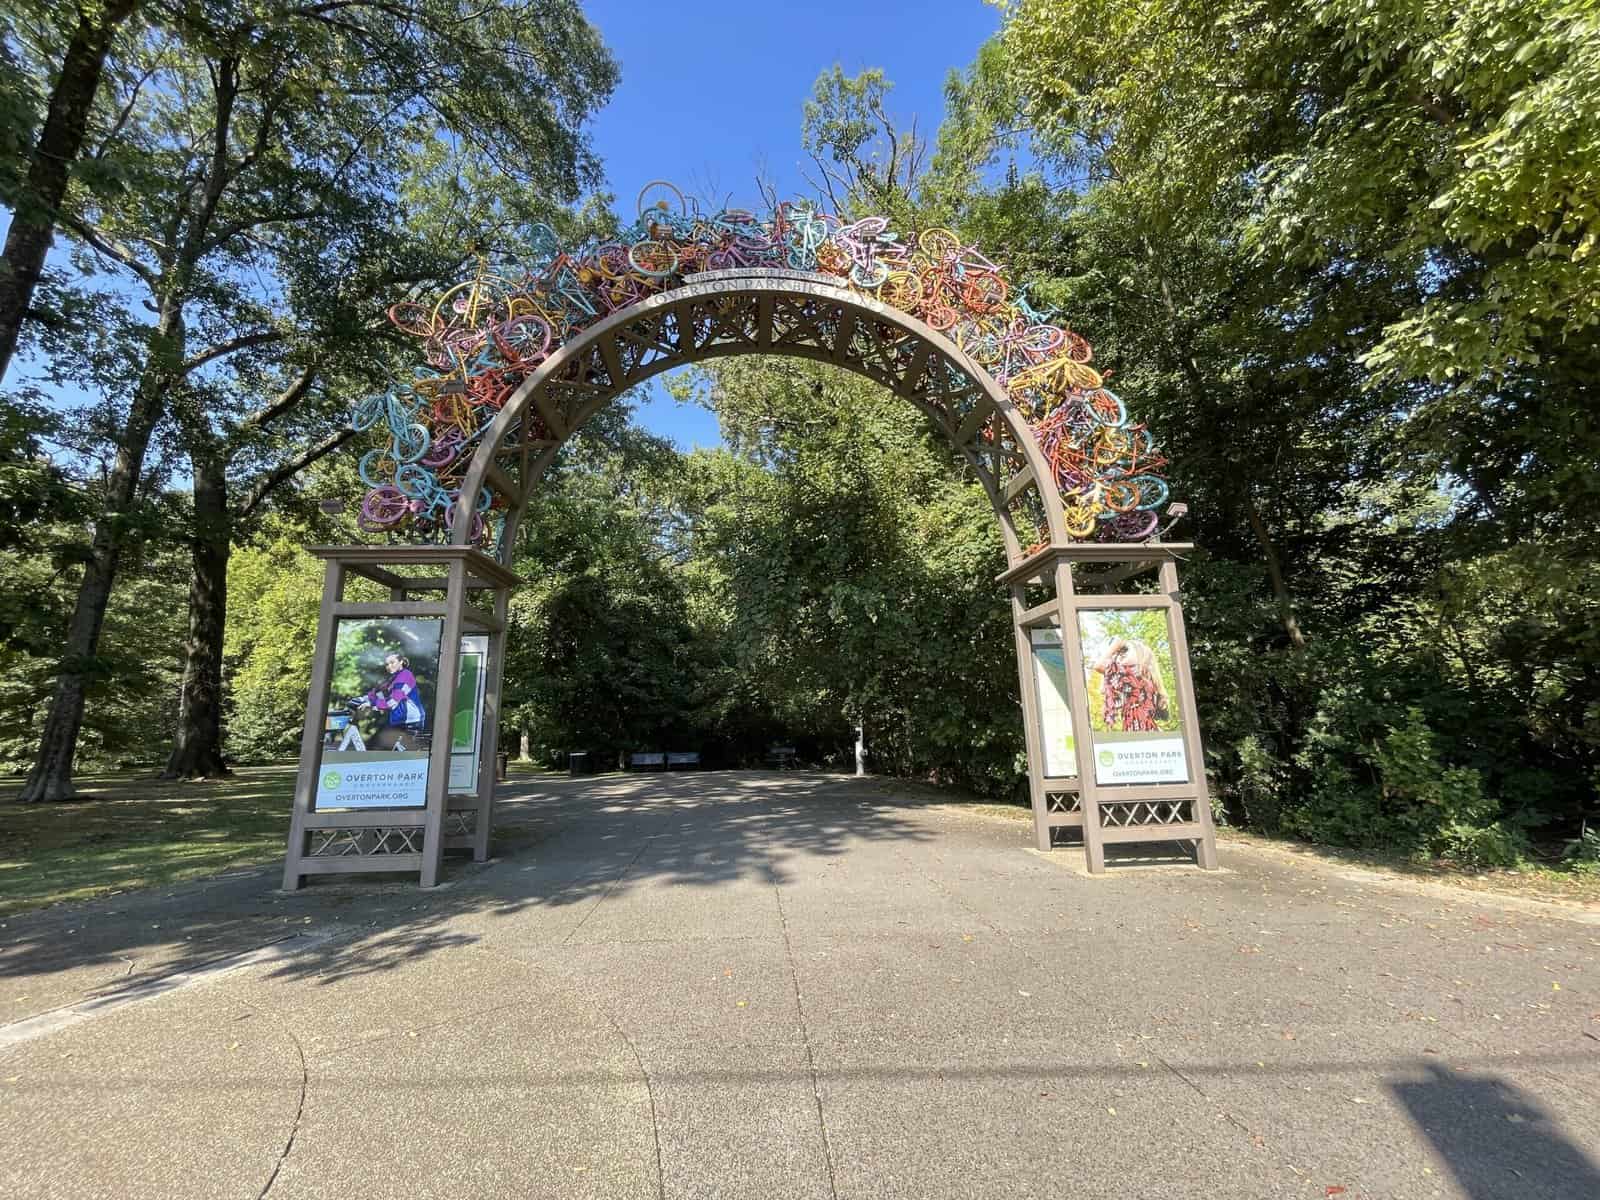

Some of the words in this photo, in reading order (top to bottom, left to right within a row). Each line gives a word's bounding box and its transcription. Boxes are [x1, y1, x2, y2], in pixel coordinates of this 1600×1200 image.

[689, 271, 718, 282] FIRST
[655, 279, 738, 306] OVERTON
[744, 279, 786, 290] PARK
[793, 281, 828, 295] BIKE
[1117, 751, 1158, 760] OVERTON
[1160, 751, 1182, 759] PARK
[345, 774, 394, 783] OVERTON
[397, 772, 425, 782] PARK
[335, 792, 409, 801] OVERTONPARK.ORG
